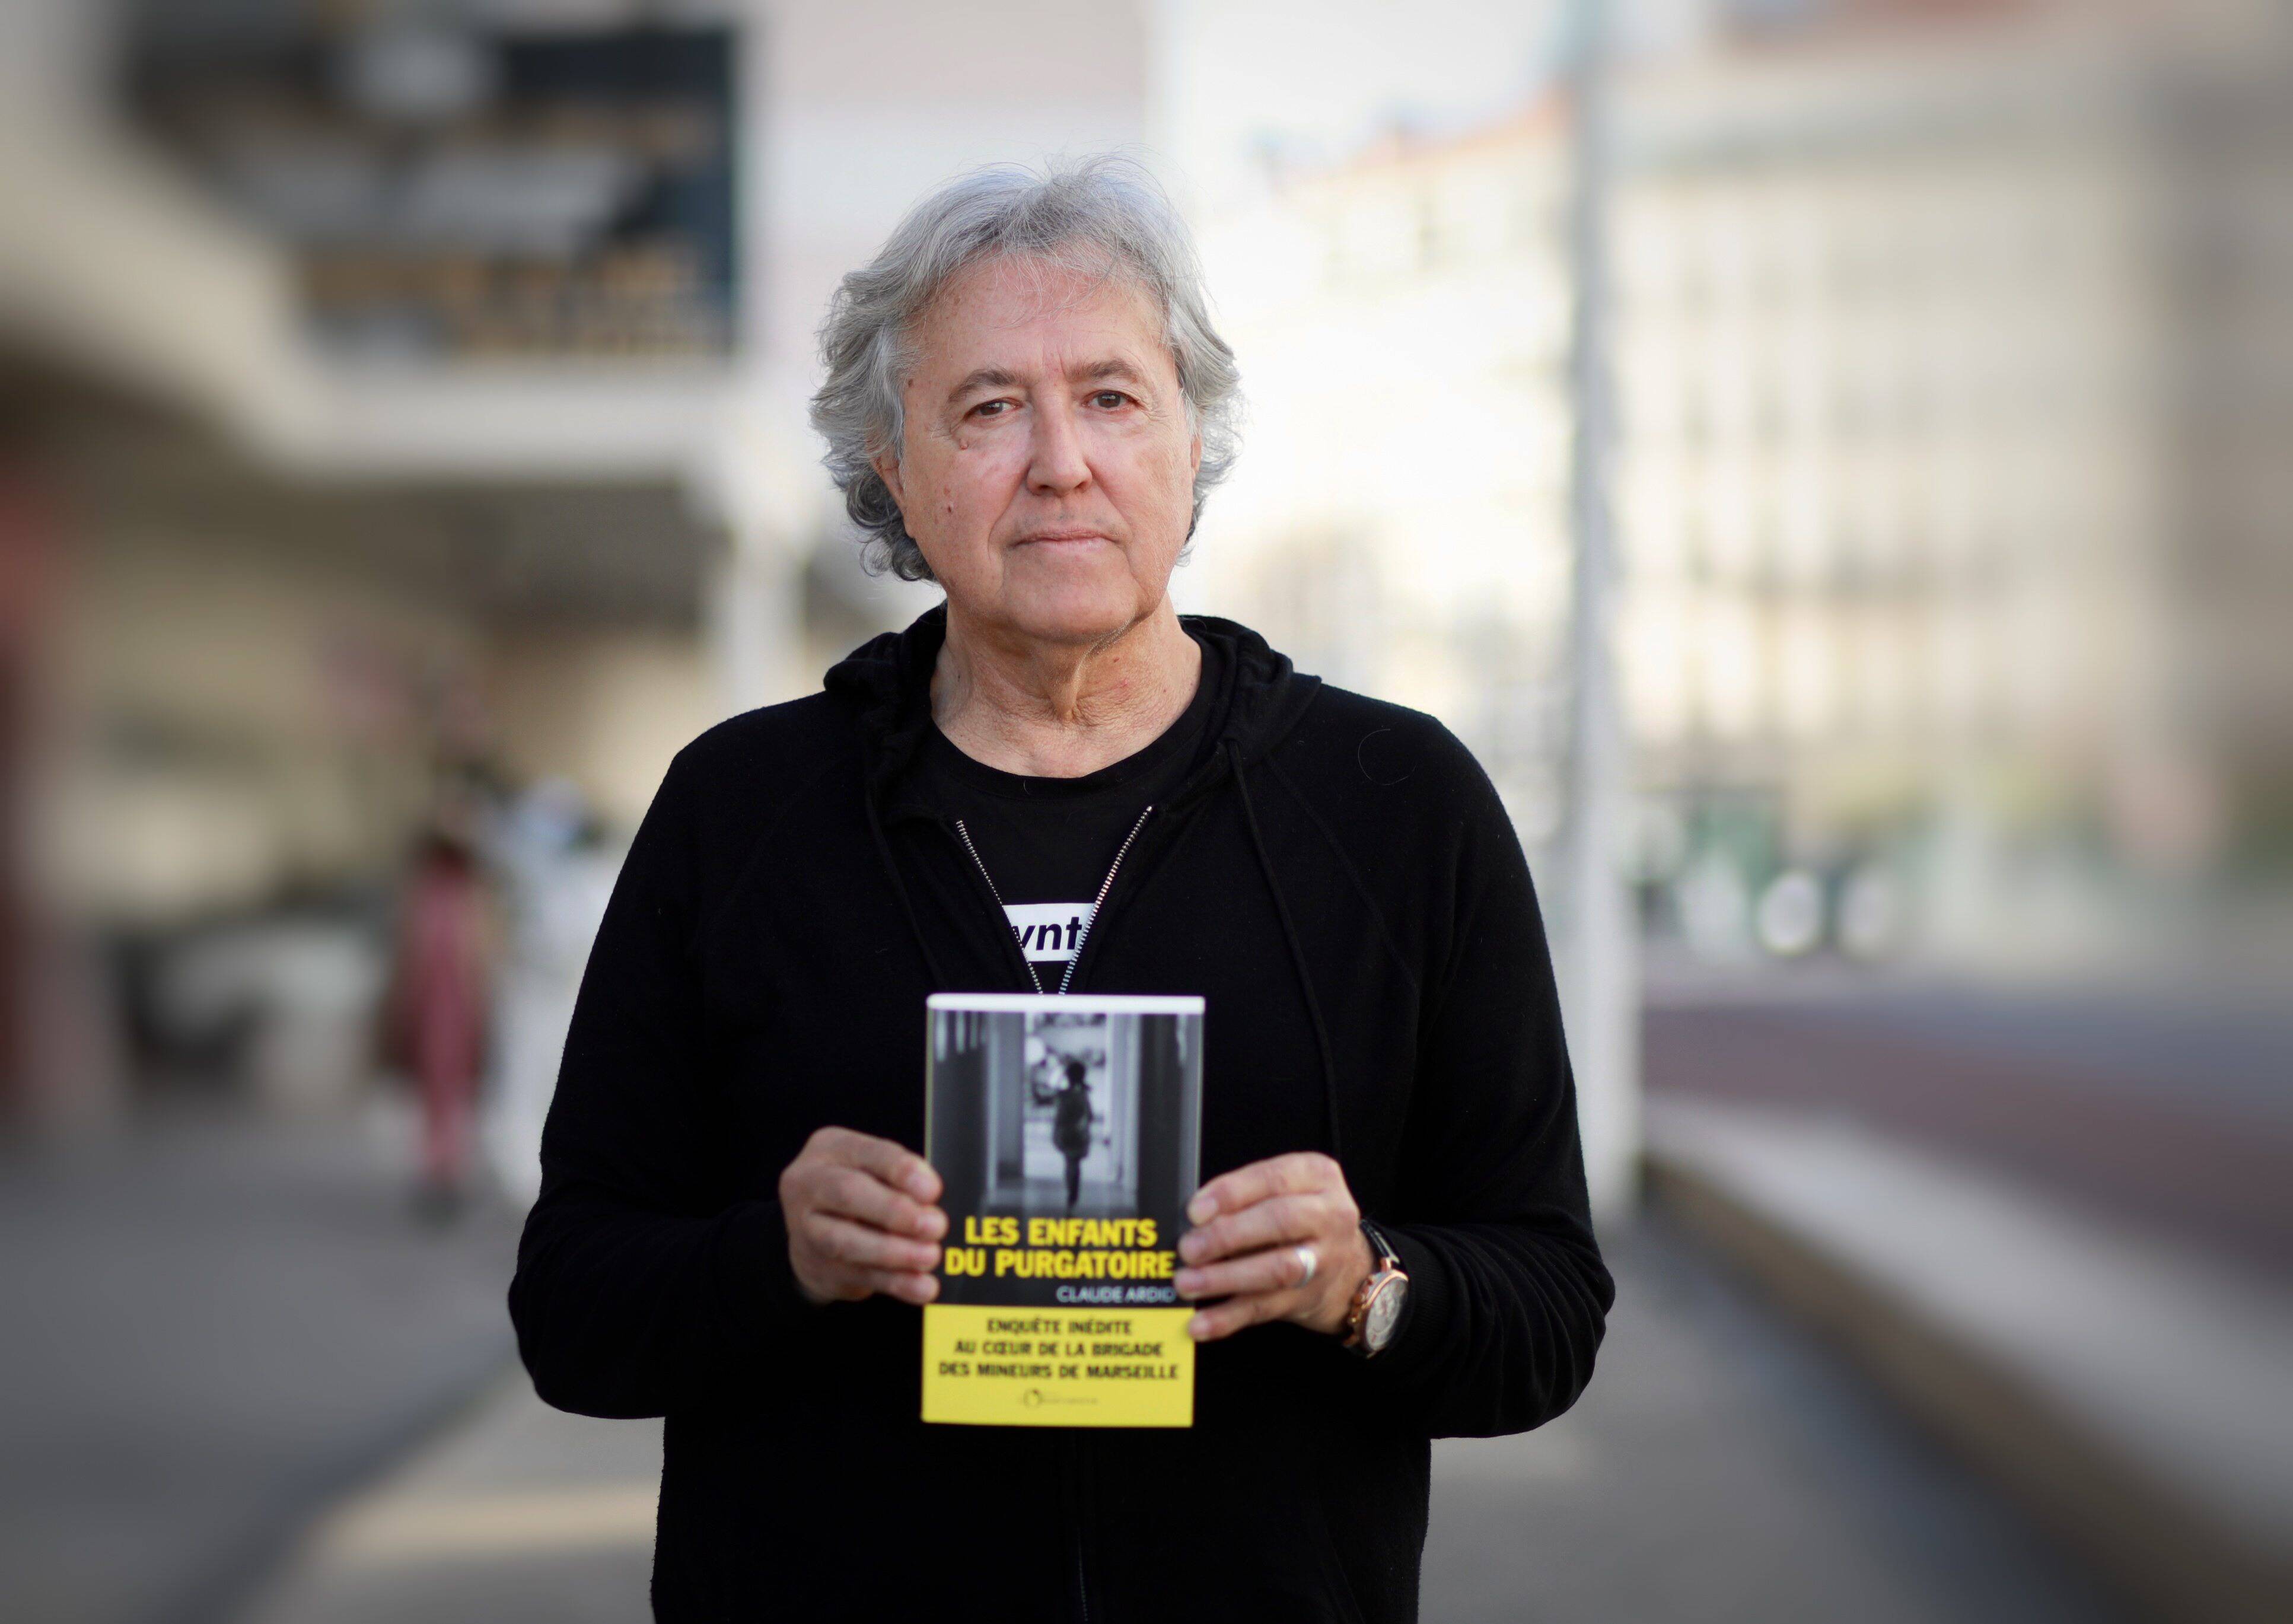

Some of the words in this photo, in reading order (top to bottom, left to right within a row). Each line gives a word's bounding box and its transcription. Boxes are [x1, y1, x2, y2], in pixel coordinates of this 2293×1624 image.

[964, 1216, 1020, 1246] LES
[1028, 1218, 1158, 1247] ENFANTS
[945, 1247, 986, 1276] DU
[995, 1249, 1175, 1279] PURGATOIRE
[1056, 1285, 1123, 1303] CLAUDE
[1068, 1317, 1130, 1334] INÉDITE
[955, 1340, 976, 1353] AU
[1039, 1342, 1058, 1355] DE
[1065, 1343, 1085, 1356] LA
[1092, 1342, 1162, 1356] BRIGADE
[940, 1362, 969, 1376] DES
[978, 1364, 1052, 1378] MINEURS
[1059, 1365, 1078, 1378] DE
[1087, 1365, 1177, 1380] MARSEILLE
